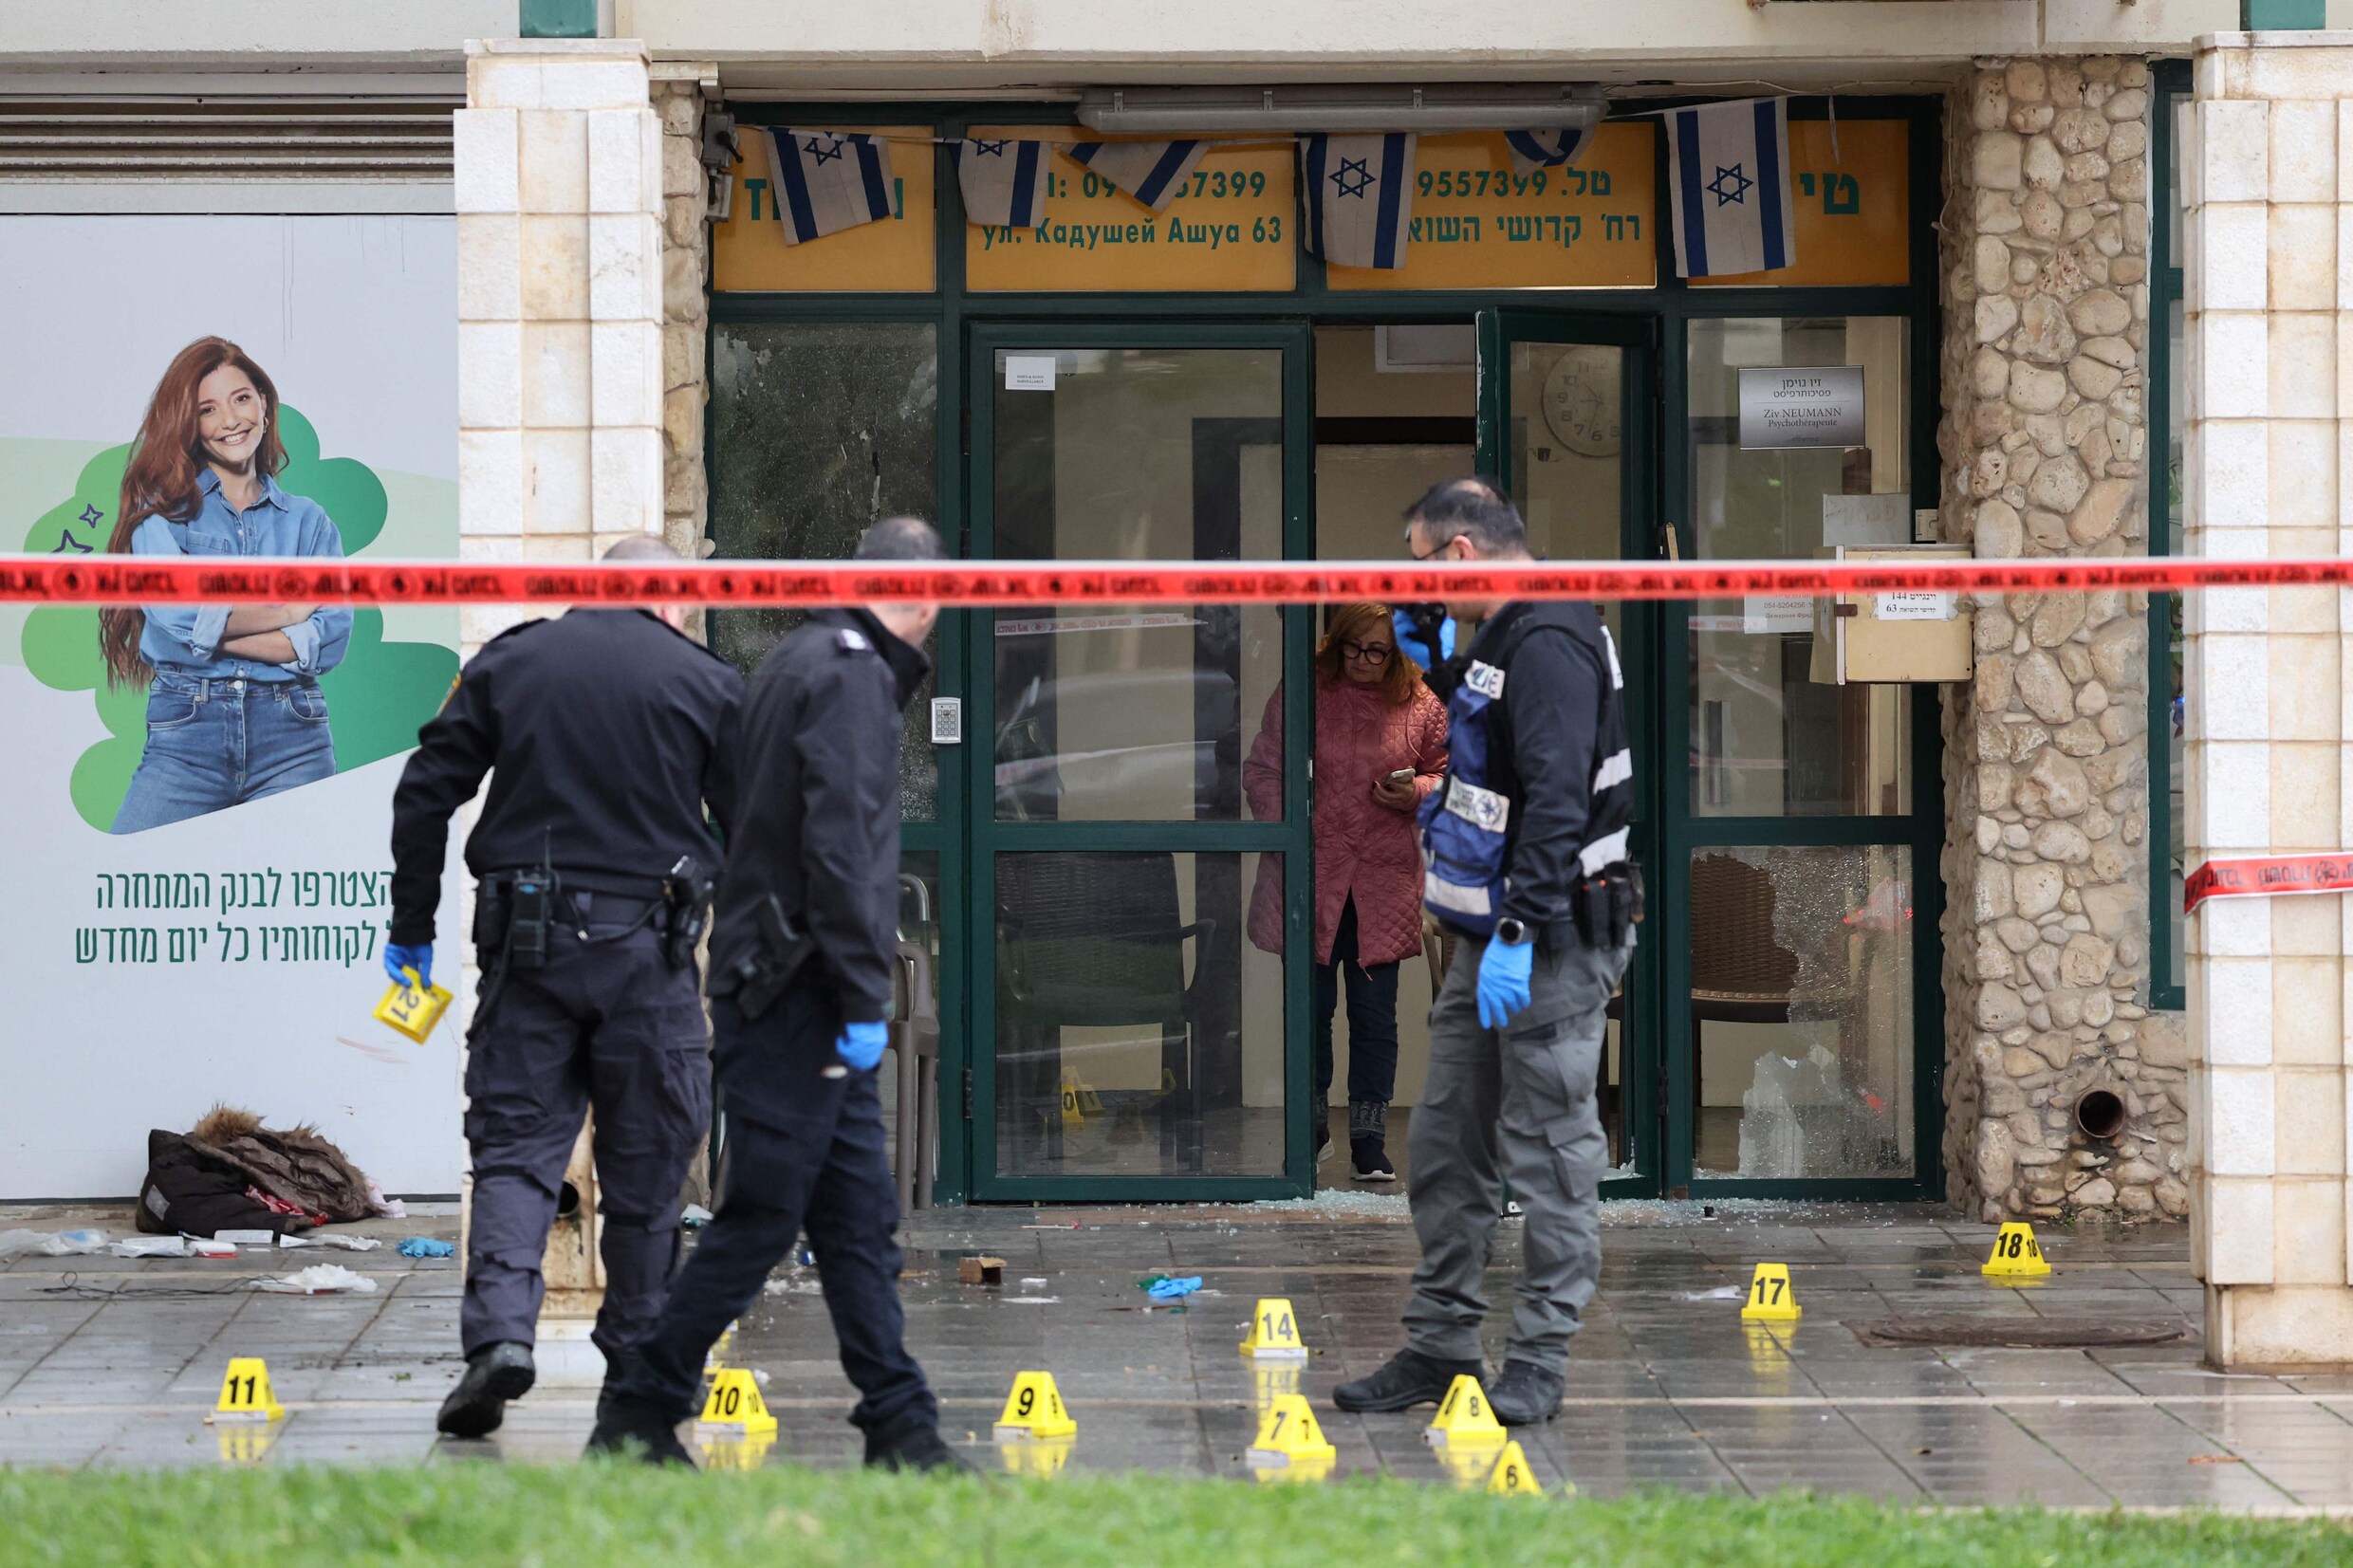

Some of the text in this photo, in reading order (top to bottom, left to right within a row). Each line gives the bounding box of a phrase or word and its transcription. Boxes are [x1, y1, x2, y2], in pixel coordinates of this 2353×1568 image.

[1035, 217, 1155, 250] Кадушей
[1167, 217, 1239, 250] Ашуа
[1252, 216, 1283, 243] 63
[1409, 216, 1480, 242] השוא
[1764, 407, 1842, 418] Ziv NEUMANN
[1886, 603, 1897, 613] 63
[97, 866, 395, 915] הצטרפו לבנק המתחרה
[76, 919, 376, 968] לקוחותיו כל יום מחדש
[1998, 1232, 2023, 1259] 18
[1755, 1276, 1786, 1305] 17
[1263, 1312, 1293, 1341] 14
[229, 1375, 255, 1404] 11
[714, 1386, 739, 1416] 10
[1018, 1387, 1034, 1416] 9
[1470, 1395, 1479, 1417] 8
[1270, 1411, 1288, 1441] 7
[1506, 1465, 1518, 1488] 6
